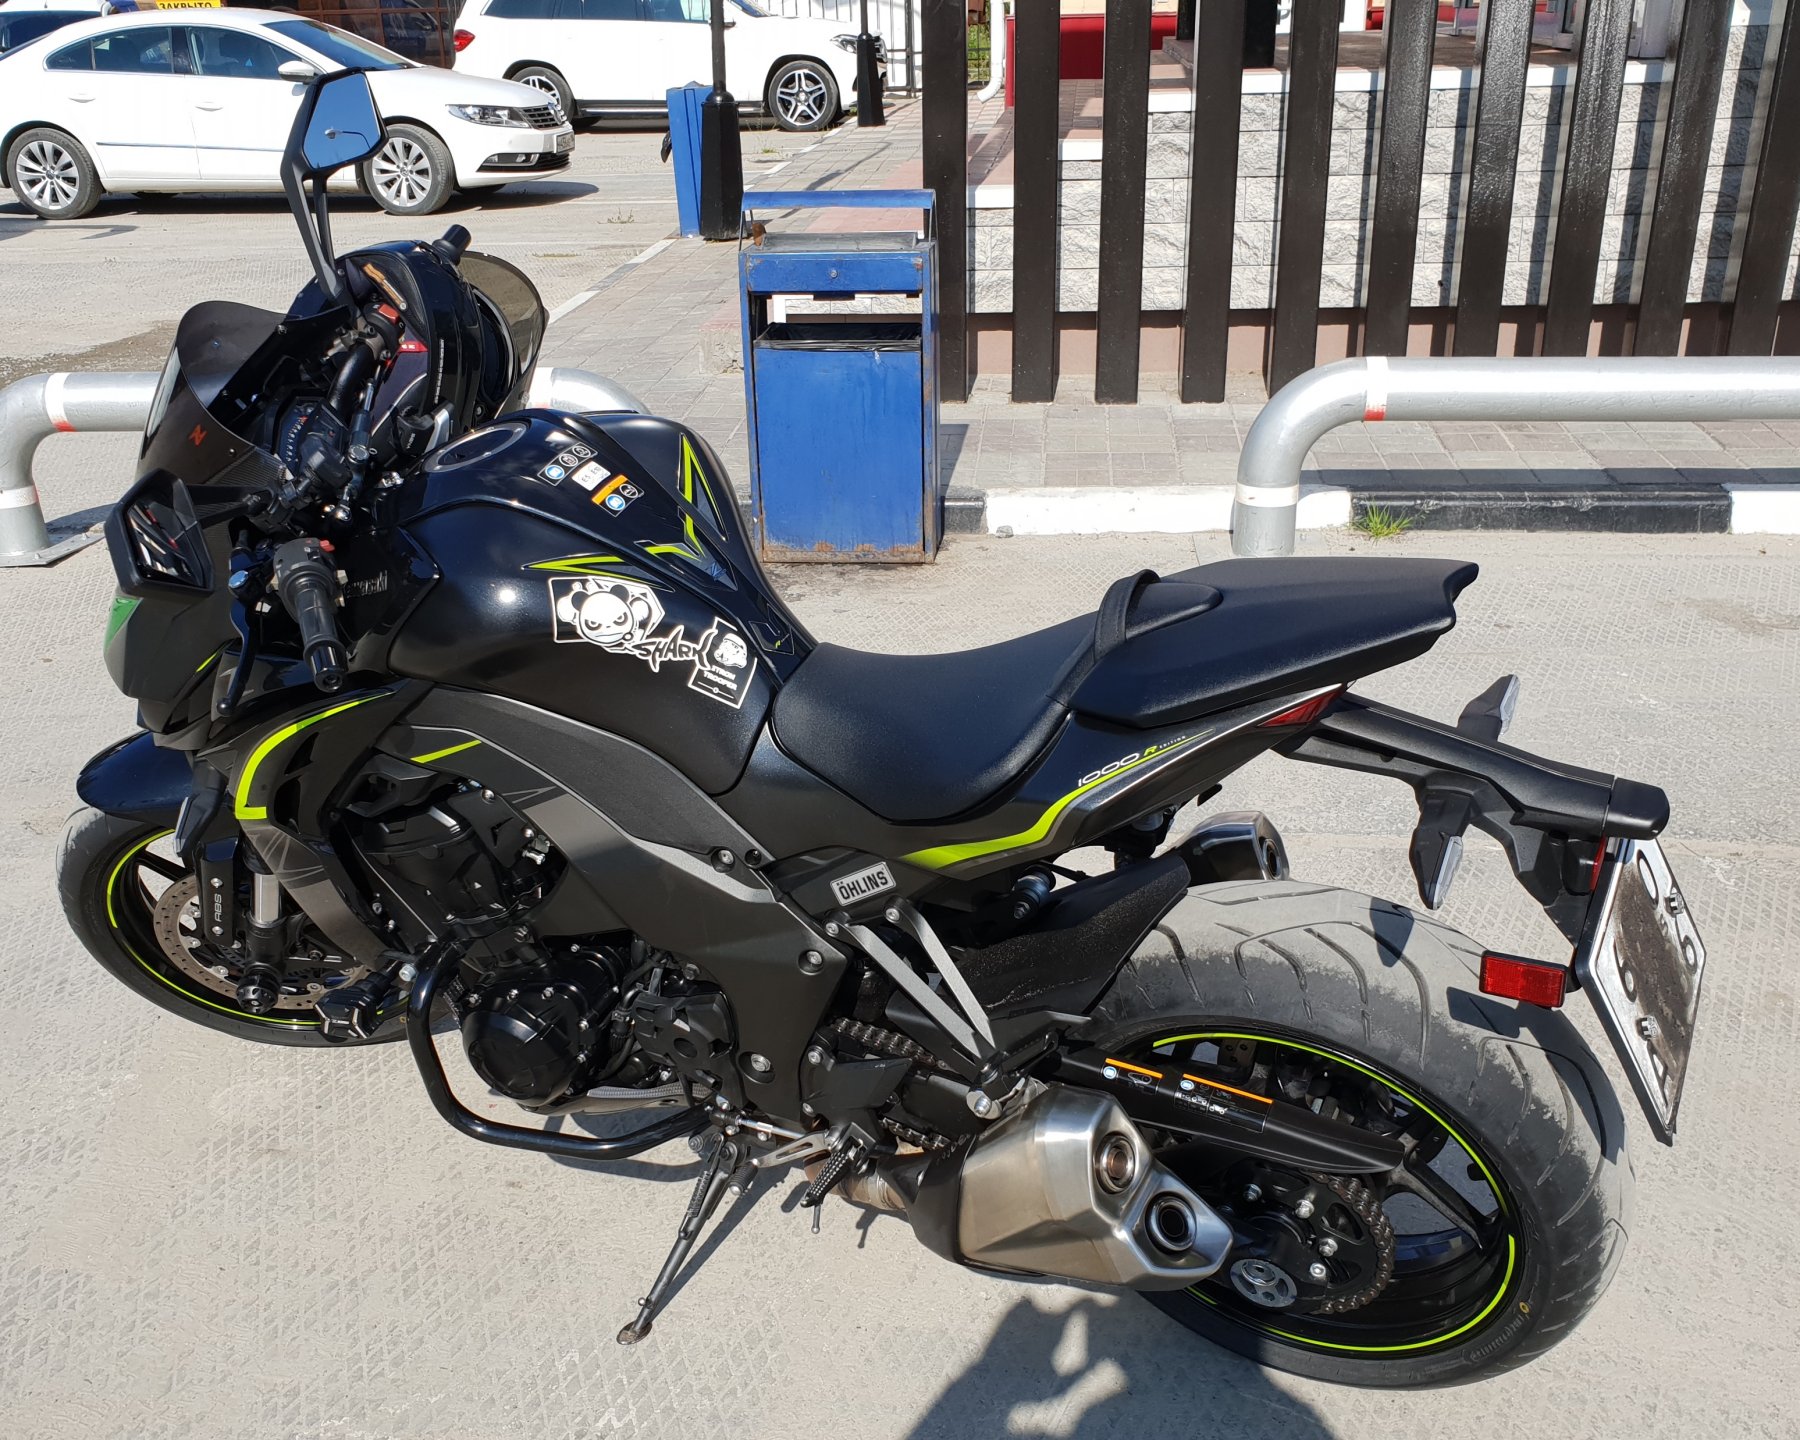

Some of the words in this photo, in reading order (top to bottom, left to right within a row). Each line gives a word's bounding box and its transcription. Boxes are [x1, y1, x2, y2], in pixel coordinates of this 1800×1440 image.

[631, 624, 719, 673] SHARK
[1078, 753, 1140, 787] 1000
[836, 871, 888, 900] ÖHLINS
[214, 893, 222, 922] ABS
